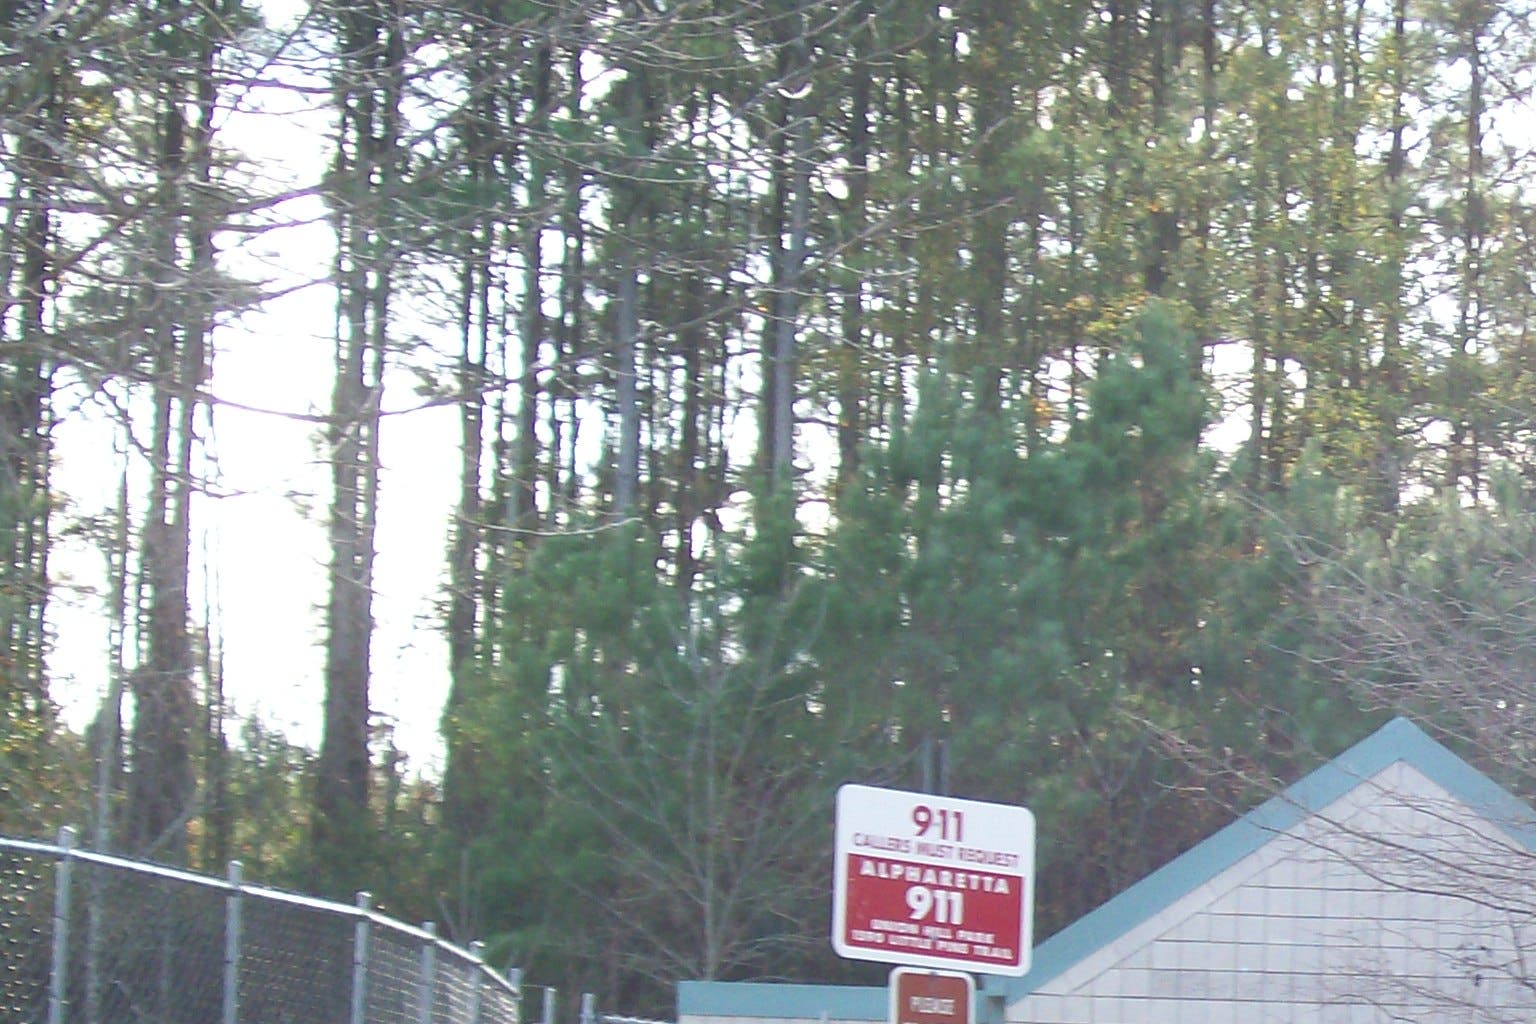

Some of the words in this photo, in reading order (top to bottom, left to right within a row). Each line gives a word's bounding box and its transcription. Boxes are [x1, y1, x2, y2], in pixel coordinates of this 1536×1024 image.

[854, 832, 910, 853] CALLERS
[917, 841, 954, 860] MUST
[959, 846, 1020, 868] REQUEST
[860, 859, 1010, 895] ALPHARETTA
[906, 885, 964, 925] 911
[910, 996, 956, 1015] PLEASE
